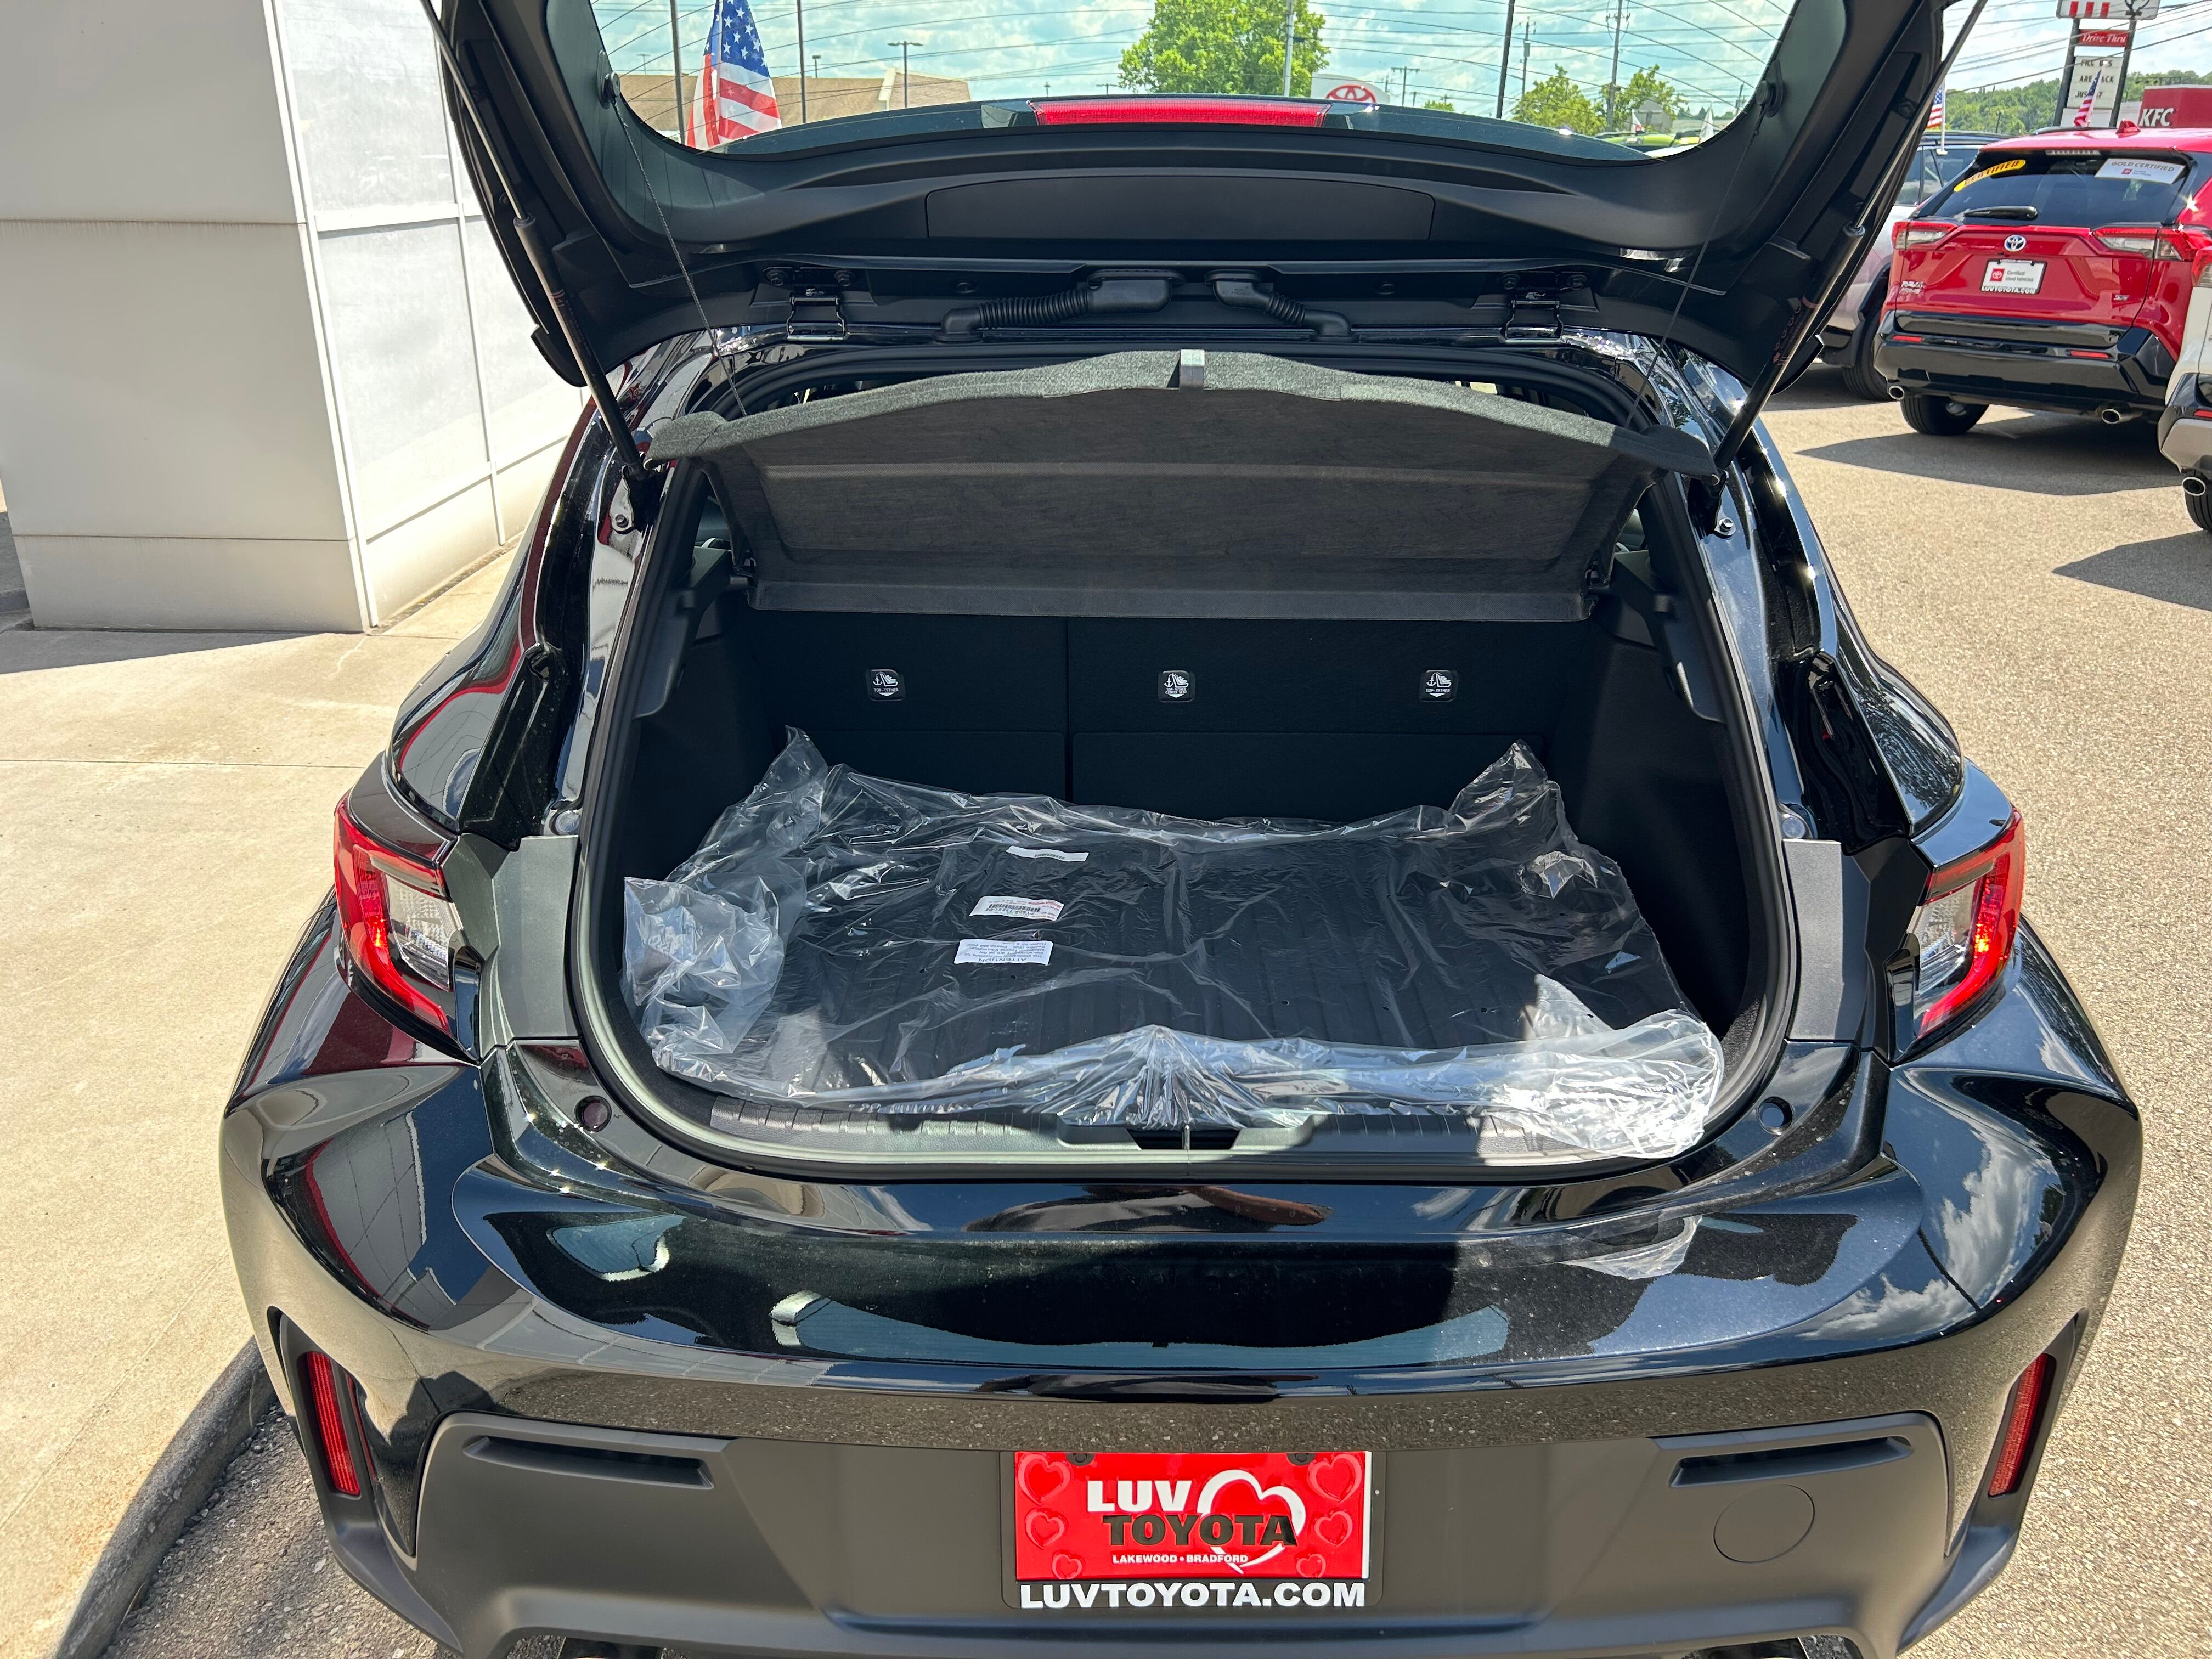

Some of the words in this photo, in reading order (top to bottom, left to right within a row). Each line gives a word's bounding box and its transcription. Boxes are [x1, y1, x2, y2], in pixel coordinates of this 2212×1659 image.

[2083, 33, 2105, 42] Drive
[2107, 33, 2127, 43] Thru
[2138, 108, 2174, 126] KFC
[2135, 163, 2174, 171] CERTIFIED
[1983, 286, 2036, 294] LUVTOYOTA.COM
[1087, 1480, 1192, 1512] LUV
[1103, 1515, 1298, 1546] TOYOTA
[1113, 1554, 1177, 1564] LAKEWOOD
[1186, 1554, 1248, 1563] BRADFORD
[1020, 1583, 1364, 1608] LUVTOYOTA.COM
